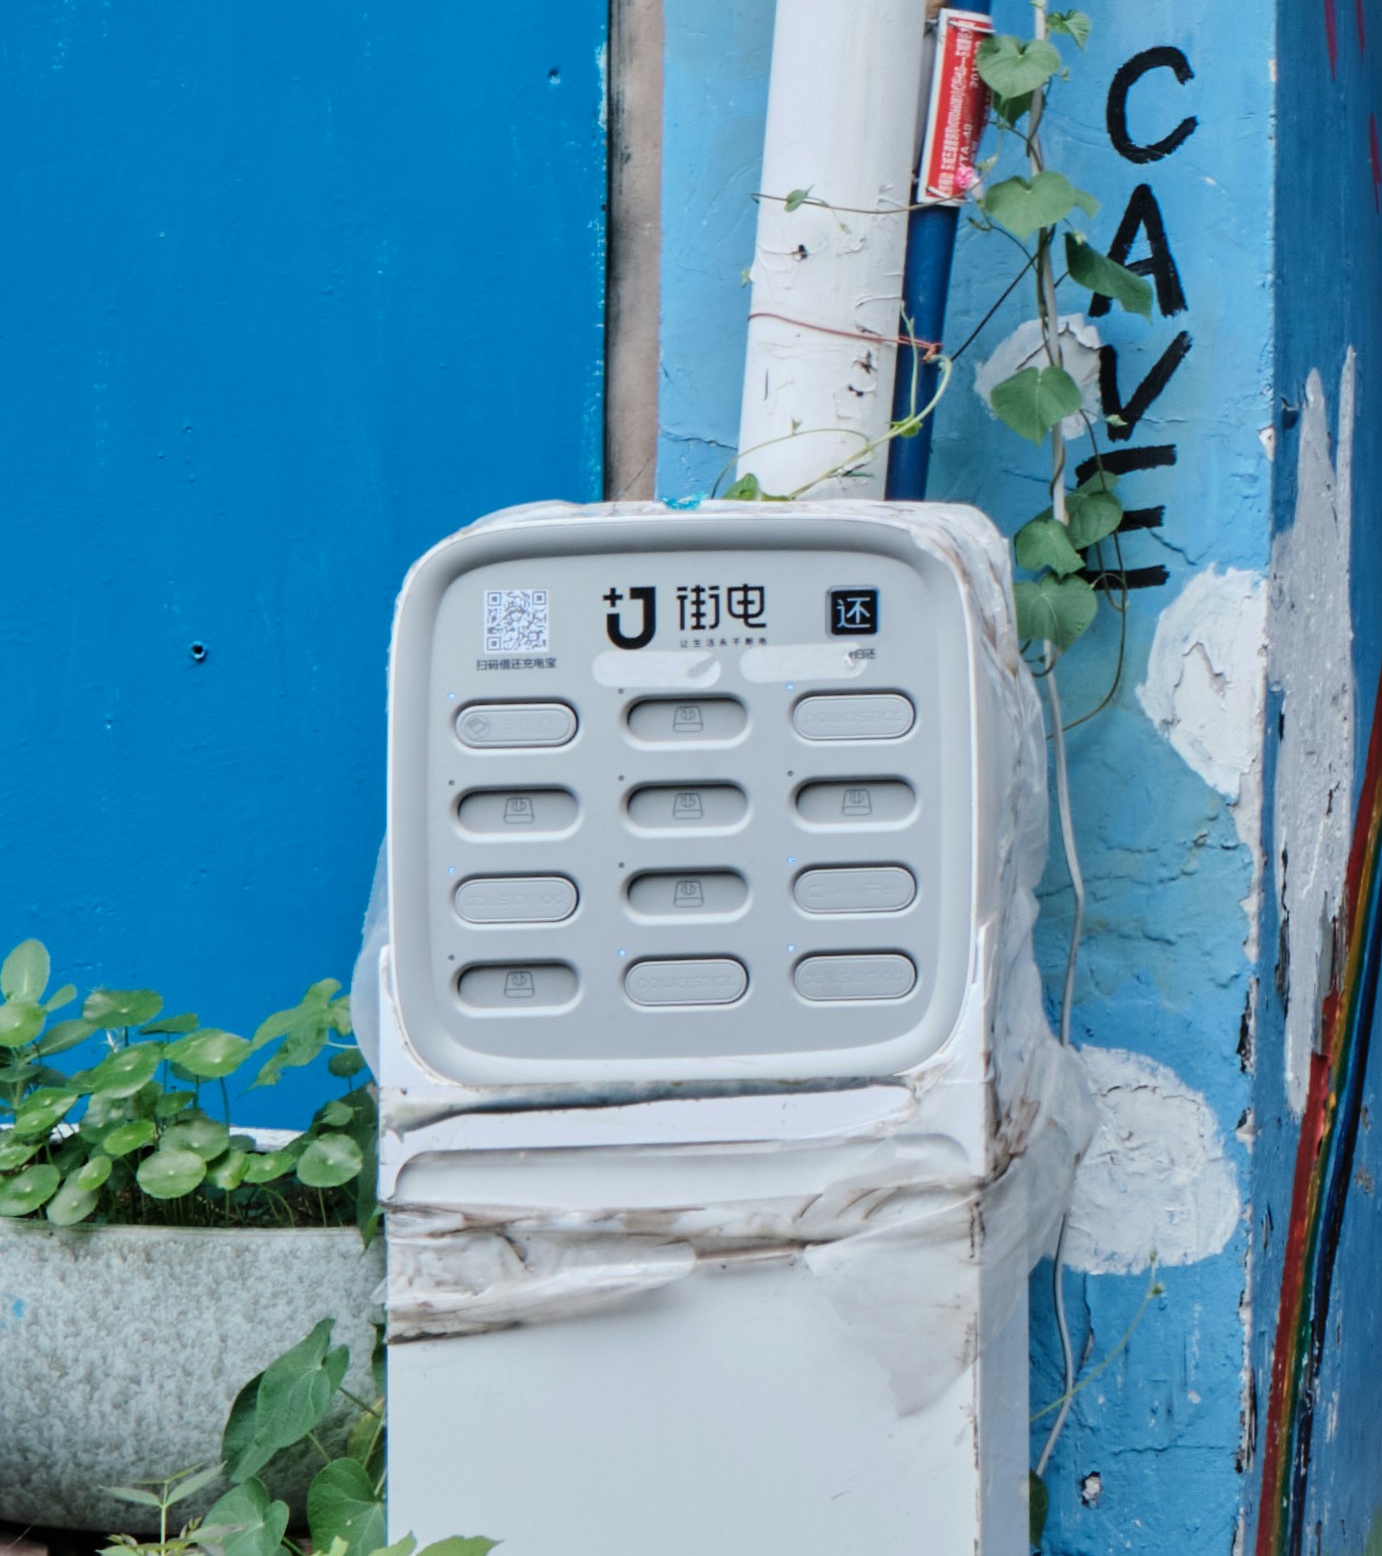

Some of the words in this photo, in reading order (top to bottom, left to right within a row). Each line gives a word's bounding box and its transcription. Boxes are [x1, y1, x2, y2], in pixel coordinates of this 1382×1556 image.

[1074, 44, 1200, 591] CAVE
[676, 583, 767, 631] 街电
[836, 596, 872, 629] 还
